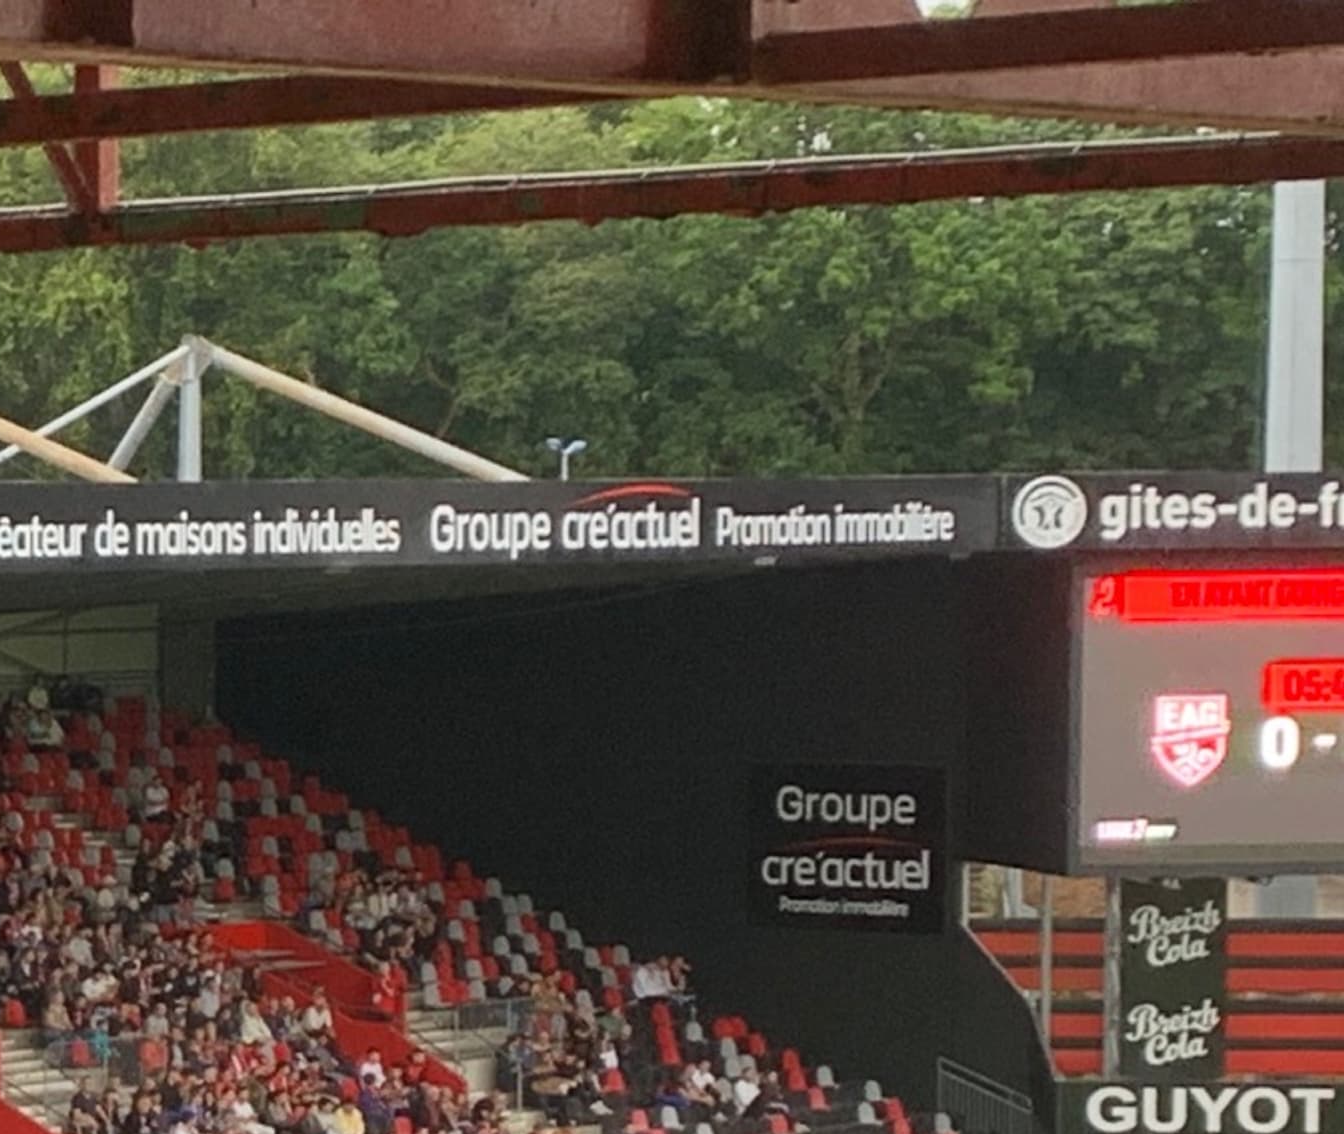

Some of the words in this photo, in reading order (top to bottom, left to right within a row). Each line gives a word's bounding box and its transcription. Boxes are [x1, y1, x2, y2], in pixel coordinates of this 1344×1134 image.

[94, 510, 131, 558] de
[137, 512, 246, 558] maisons
[254, 508, 400, 555] individuelles
[431, 504, 551, 559] Groupe
[715, 506, 831, 547] Promotion
[1165, 703, 1220, 730] EAG
[1260, 716, 1300, 768] 0
[776, 785, 916, 831] Groupe
[1128, 900, 1221, 943] Breizh
[1147, 933, 1210, 966] Cola
[1125, 999, 1220, 1042] Breizh
[1144, 1030, 1208, 1065] Cola
[1087, 1086, 1335, 1134] GUYOT
